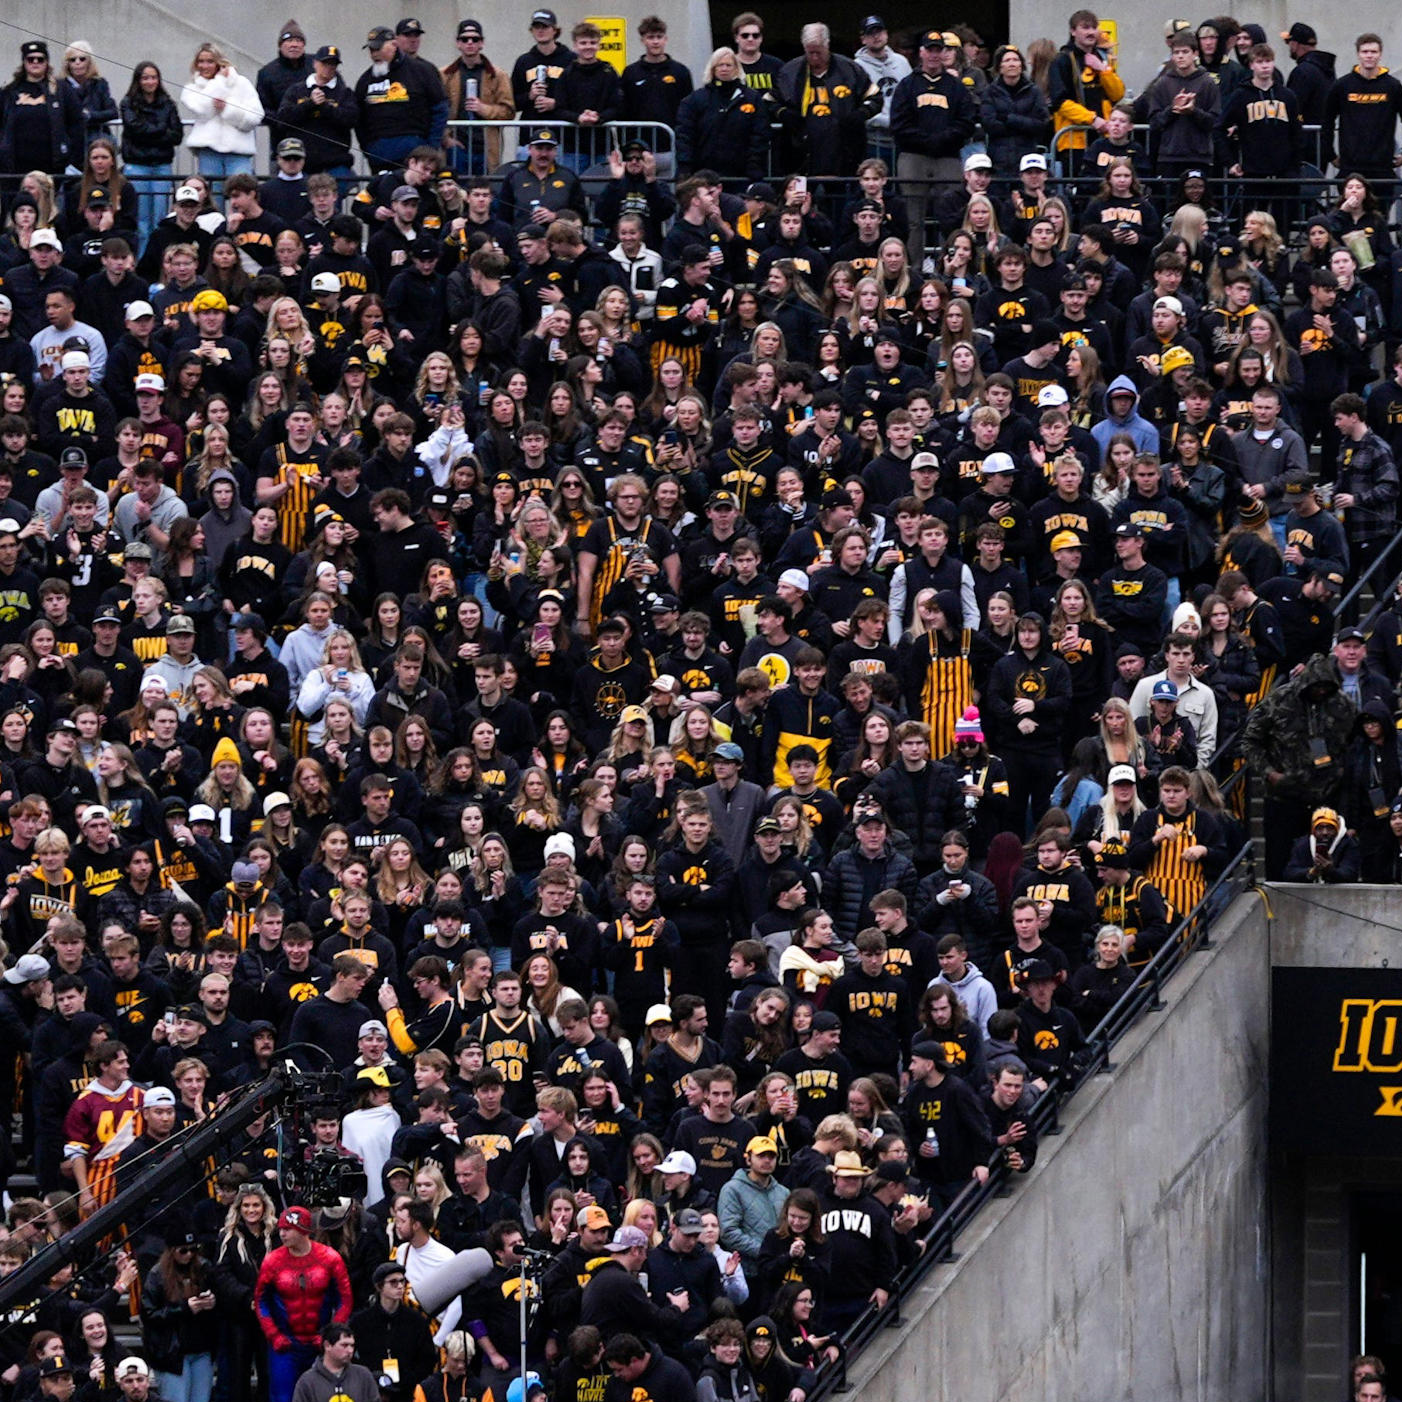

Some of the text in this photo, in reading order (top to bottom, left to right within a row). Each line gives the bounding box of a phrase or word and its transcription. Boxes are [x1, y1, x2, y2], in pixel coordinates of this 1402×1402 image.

[1247, 100, 1288, 124] IOWA
[1101, 206, 1142, 224] IOWA
[959, 460, 983, 475] IOW
[1044, 514, 1089, 532] IOWA
[1130, 509, 1168, 523] IOWA
[73, 552, 92, 586] 3
[237, 555, 275, 580] IOWA
[132, 637, 168, 662] IOWA
[84, 864, 123, 886] Iowa
[1026, 884, 1070, 903] IOWA
[31, 894, 76, 916] IOWA
[634, 950, 645, 972] 1
[849, 992, 897, 1011] IOWA
[487, 1041, 528, 1062] IOWA
[795, 1072, 838, 1091] IOWA
[819, 1210, 871, 1239] IOWA
